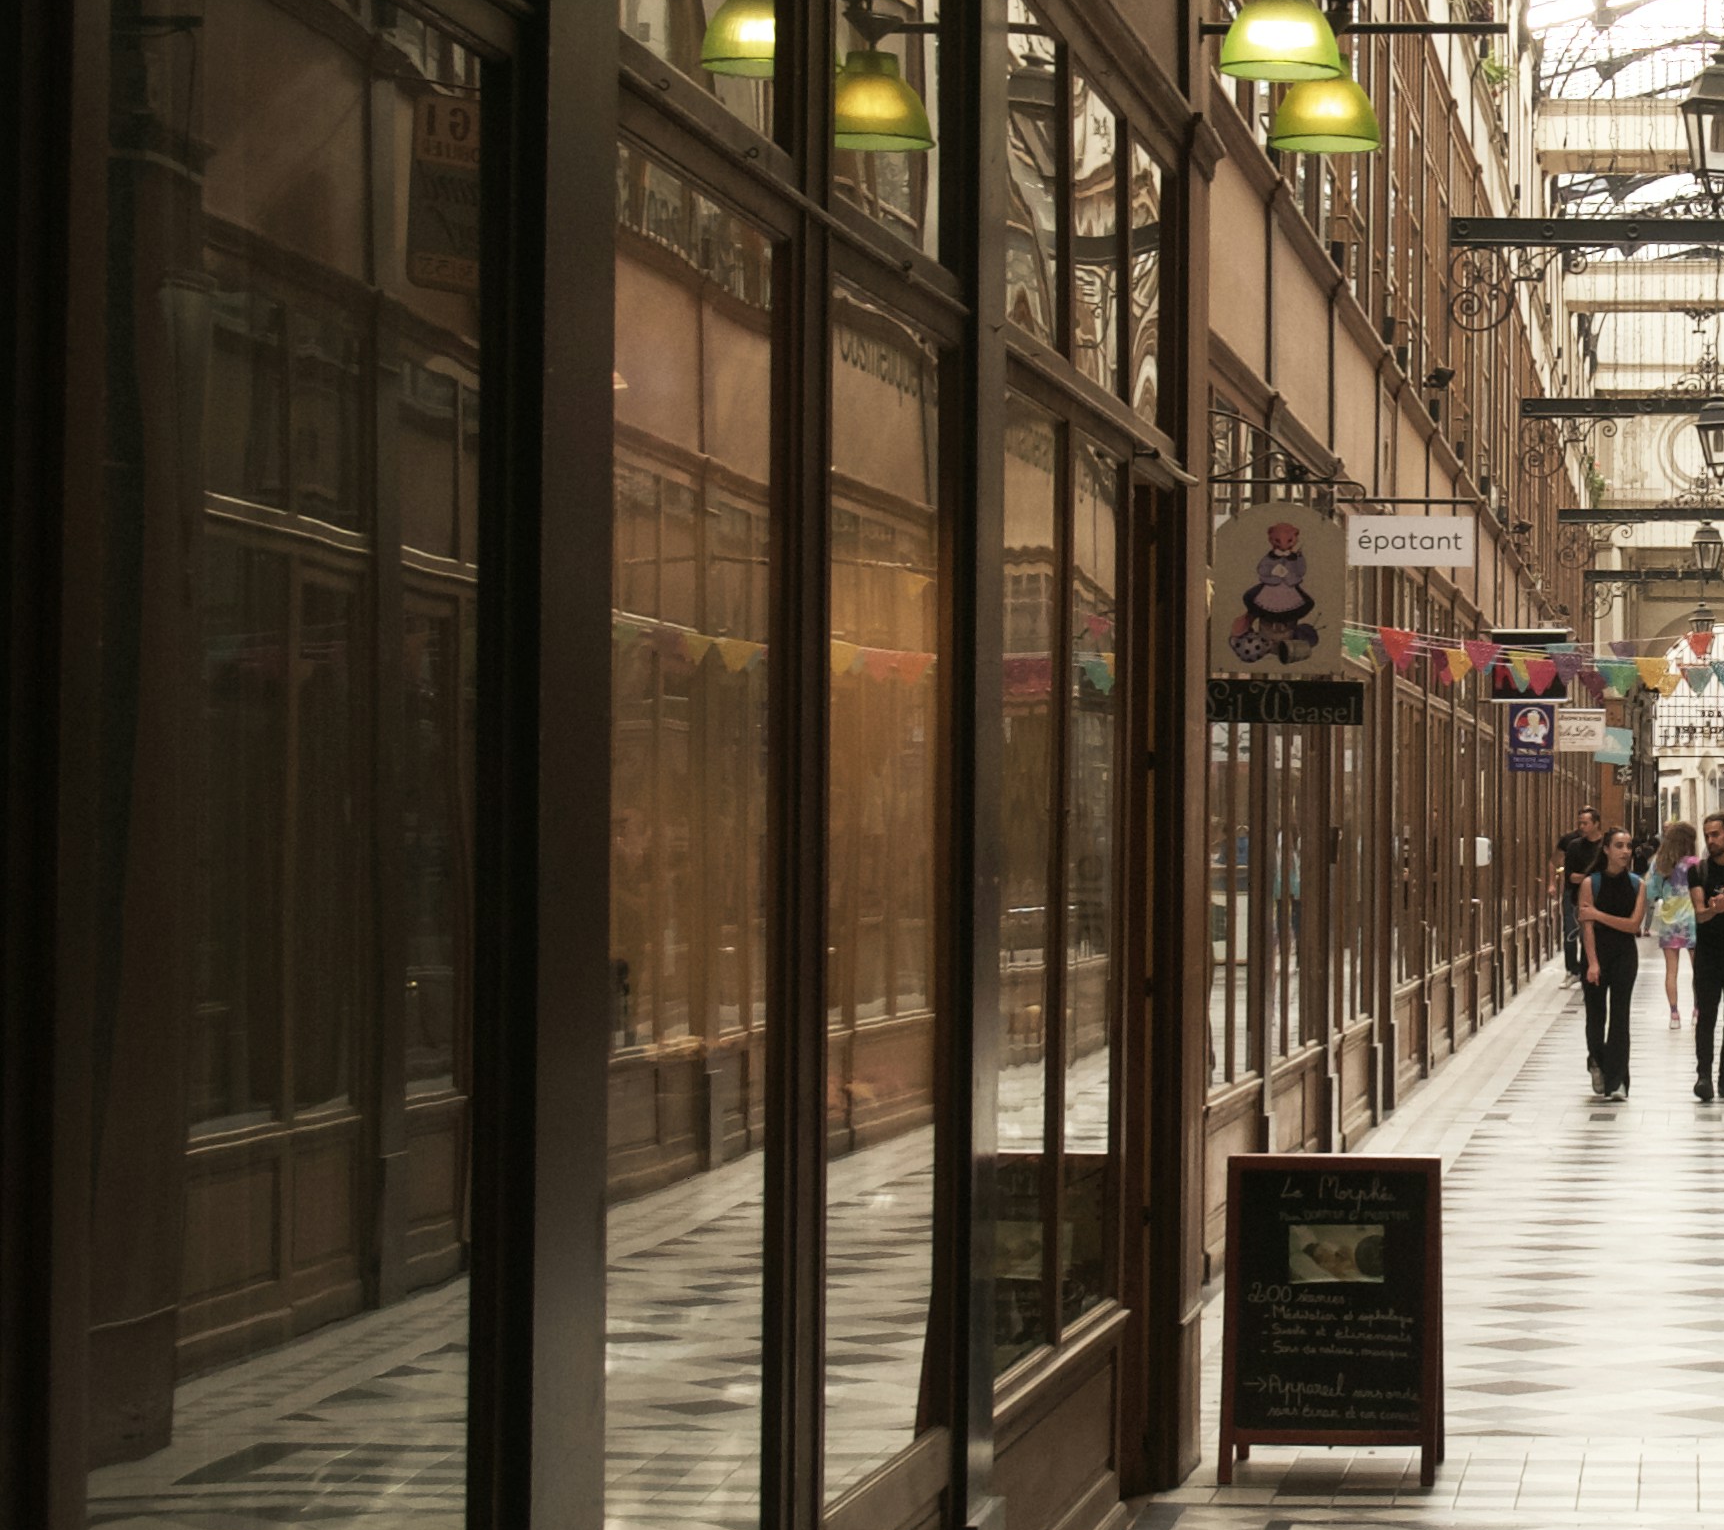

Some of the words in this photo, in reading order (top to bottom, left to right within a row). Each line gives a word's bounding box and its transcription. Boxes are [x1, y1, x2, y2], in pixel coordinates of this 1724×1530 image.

[1358, 529, 1462, 554] épatant
[1207, 680, 1245, 721] Lil
[1249, 681, 1356, 724] Weasel
[1247, 1281, 1292, 1303] 200
